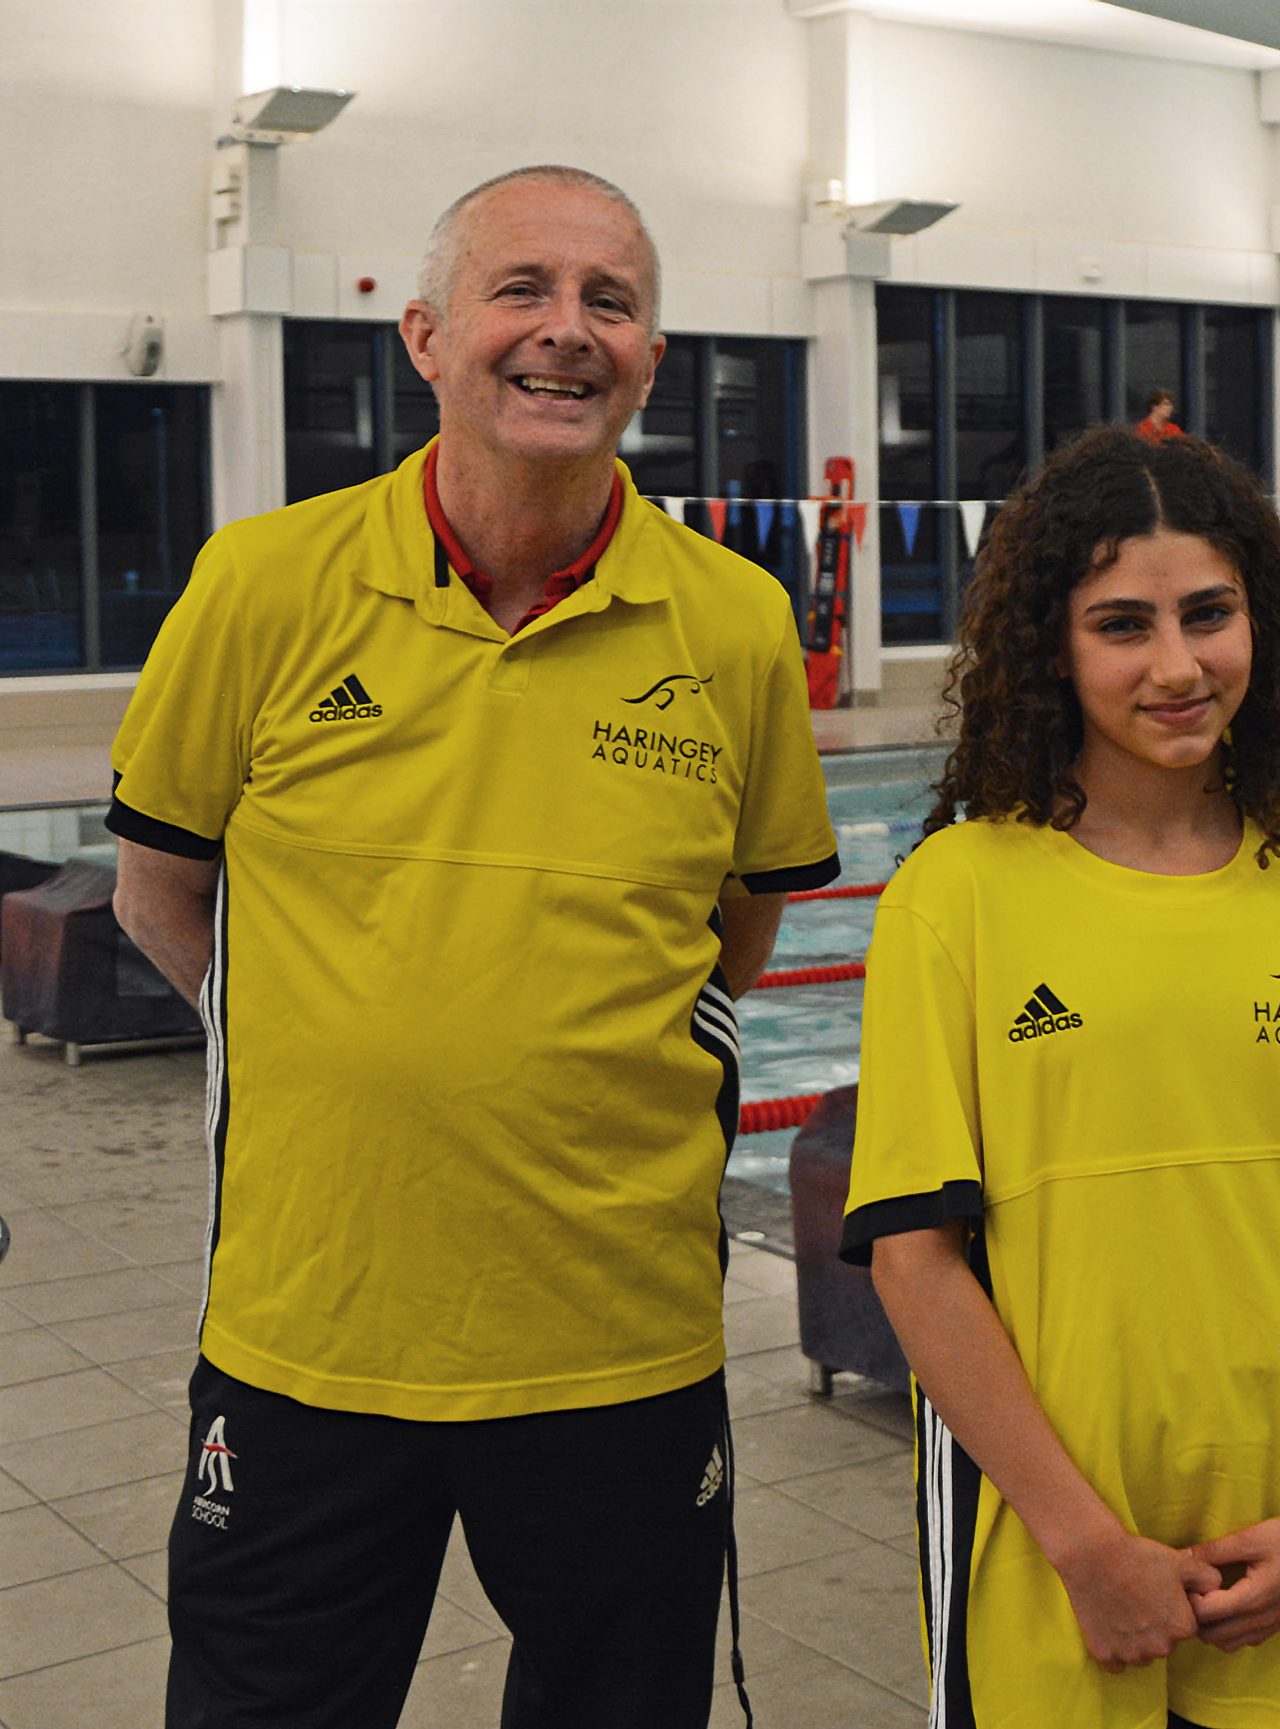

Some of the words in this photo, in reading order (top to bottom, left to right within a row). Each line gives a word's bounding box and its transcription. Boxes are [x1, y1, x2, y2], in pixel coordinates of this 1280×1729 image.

[308, 703, 383, 722] adidas
[592, 720, 723, 764] HARINGEY
[592, 744, 718, 784] AQUATICS
[1008, 1013, 1083, 1042] adidas
[191, 1504, 229, 1530] SCHOOL
